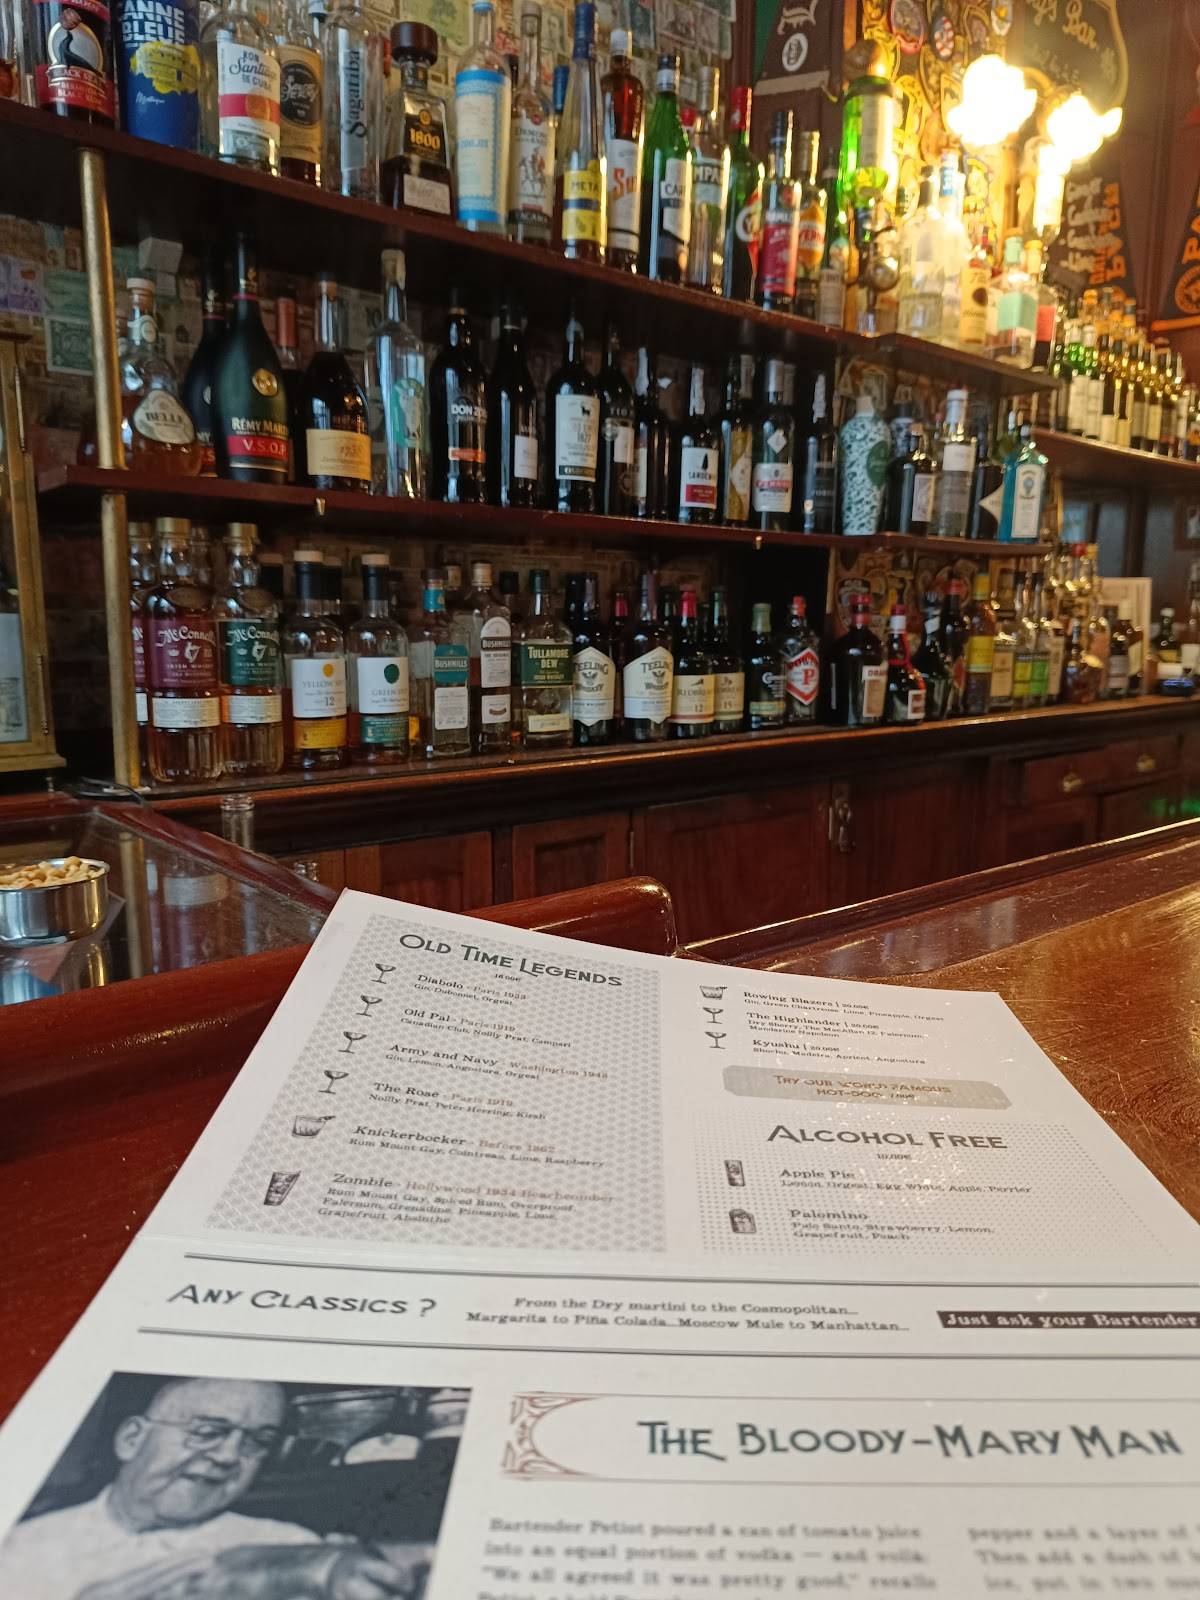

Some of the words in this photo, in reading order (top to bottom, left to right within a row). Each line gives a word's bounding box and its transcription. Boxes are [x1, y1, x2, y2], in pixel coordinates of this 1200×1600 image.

[409, 128, 441, 150] 1800
[527, 646, 570, 660] TULLAMORE
[434, 658, 468, 669] BUSHMILLS
[540, 659, 560, 670] DEW
[400, 933, 452, 955] OLD
[460, 943, 514, 969] TIME
[519, 957, 623, 987] LEGENDS
[417, 974, 464, 991] Diabolo
[743, 991, 788, 1004] Rowing
[790, 996, 835, 1007] Blazers
[762, 1000, 789, 1009] Green
[404, 1008, 426, 1019] Old
[429, 1011, 451, 1022] Pal
[746, 1012, 771, 1021] The
[773, 1013, 841, 1027] Highlander
[400, 1017, 445, 1031] Canadian
[531, 1037, 572, 1049] Campari
[748, 1020, 766, 1029] Dry
[804, 1024, 822, 1032] The
[752, 1039, 801, 1051] Kyushu
[389, 1044, 430, 1057] Army
[432, 1050, 458, 1061] and
[461, 1053, 499, 1067] Navy
[875, 1056, 927, 1066] Angostura
[504, 1069, 540, 1081] Orgeat
[373, 1081, 401, 1094] The
[405, 1085, 440, 1099] Rose
[773, 1074, 800, 1086] TRY
[802, 1078, 833, 1088] OUR
[890, 1083, 952, 1094] FAMOUS
[435, 1101, 464, 1112] Peter
[351, 1124, 468, 1147] Knickerbocker
[479, 1139, 523, 1152] Before
[766, 1124, 924, 1147] ALCOHOL
[928, 1131, 1009, 1149] FREE
[348, 1137, 376, 1149] Rum
[379, 1141, 417, 1152] Mount
[544, 1155, 606, 1168] Raspberry
[779, 1168, 825, 1180] Apple
[829, 1169, 856, 1179] Pie
[331, 1172, 394, 1190] Zombie
[405, 1179, 482, 1194] Hollywood
[875, 1182, 901, 1192] Egg
[985, 1185, 1033, 1194] Perrier
[326, 1186, 356, 1198] Rum
[358, 1189, 399, 1201] Mount
[391, 1212, 452, 1225] Absinthe
[789, 1208, 869, 1221] Palomino
[871, 1231, 911, 1241] Peach
[166, 1283, 245, 1305] ANY
[249, 1288, 410, 1315] CLASSICS
[513, 1297, 558, 1309] From
[561, 1297, 589, 1310] the
[592, 1299, 624, 1313] Dry
[627, 1301, 687, 1313] martini
[689, 1304, 707, 1314] to
[710, 1303, 738, 1314] the
[465, 1311, 548, 1326] Margarita
[551, 1313, 569, 1324] to
[745, 1318, 785, 1330] Mule
[788, 1319, 806, 1330] to
[946, 1313, 992, 1327] Just
[996, 1313, 1034, 1327] ask
[1038, 1315, 1088, 1328] your
[1092, 1313, 1200, 1328] Bartender
[637, 1420, 728, 1462] THE
[736, 1422, 1061, 1459] BLOODY-MARY
[1069, 1423, 1184, 1459] MAN
[489, 1516, 584, 1535] Bartender
[650, 1522, 716, 1541] poured
[738, 1526, 772, 1539] can
[776, 1522, 797, 1539] of
[802, 1524, 872, 1540] tomato
[876, 1523, 922, 1542] juice
[483, 1541, 523, 1558] into
[529, 1545, 556, 1558] an
[563, 1544, 618, 1562] equal
[625, 1544, 700, 1563] portion
[706, 1544, 727, 1562] of
[734, 1546, 795, 1563] vodka
[831, 1546, 869, 1563] and
[528, 1566, 555, 1584] all
[564, 1568, 634, 1588] agreed
[642, 1568, 660, 1586] it
[670, 1572, 710, 1588] was
[719, 1570, 786, 1592] pretty
